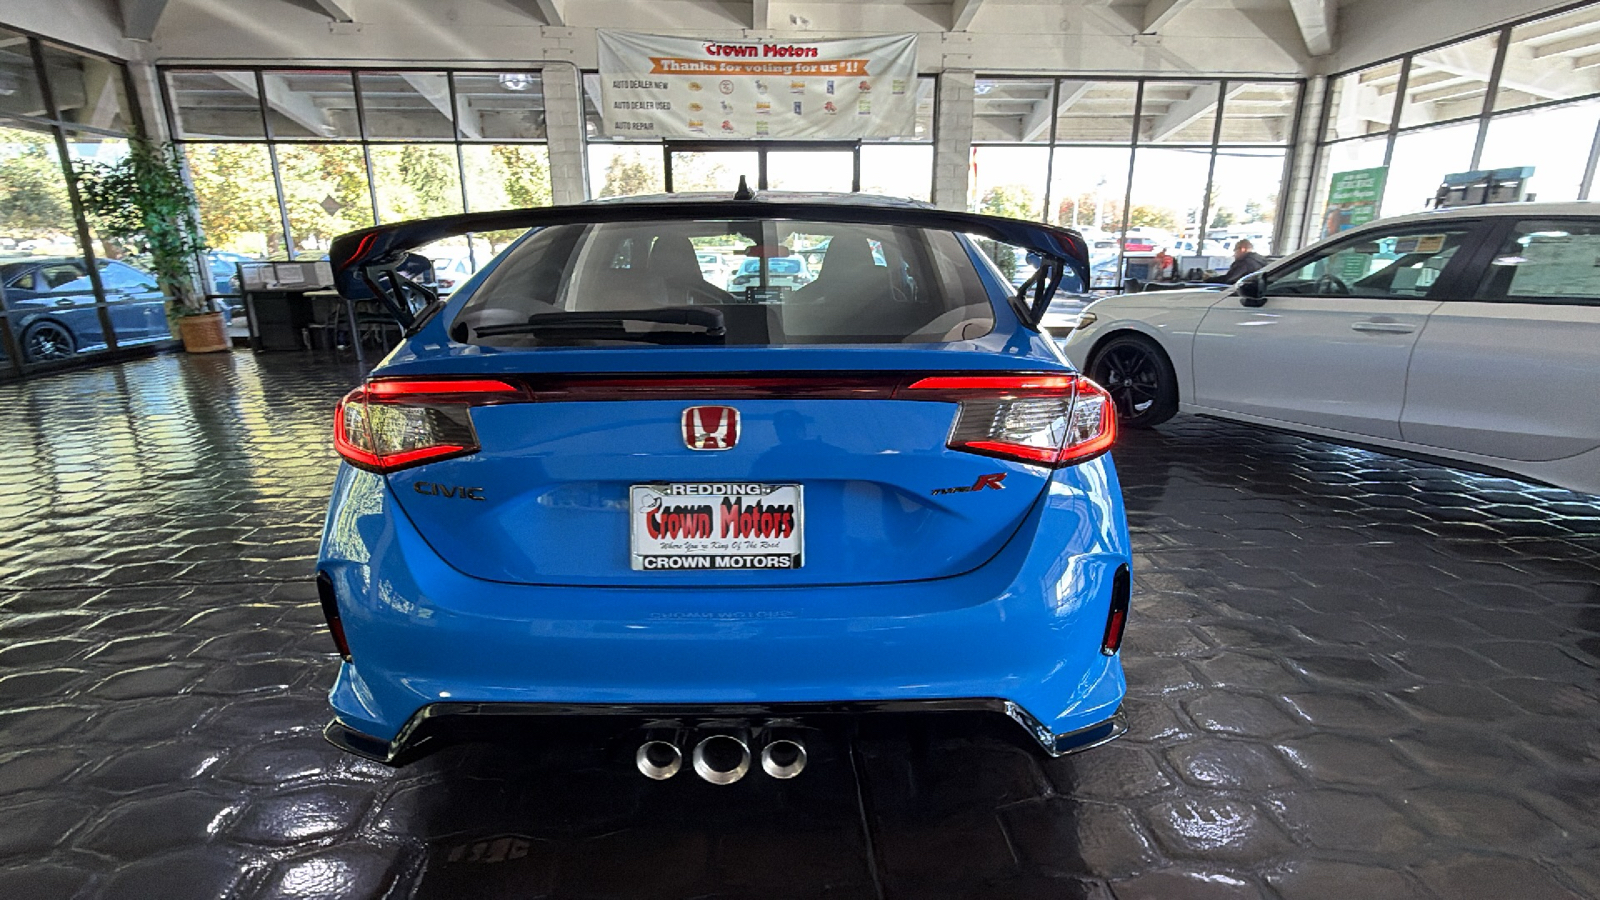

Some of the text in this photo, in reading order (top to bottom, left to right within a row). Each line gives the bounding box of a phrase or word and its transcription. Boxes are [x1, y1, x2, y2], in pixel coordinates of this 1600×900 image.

[705, 42, 818, 58] Crown Motors
[661, 60, 717, 71] Thanks
[719, 62, 742, 72] for
[745, 62, 793, 75] voting
[795, 62, 818, 72] for
[820, 64, 838, 73] us
[613, 80, 669, 90] AUTO DEALER NEW
[614, 101, 671, 110] AUTO DEALER USED
[615, 122, 654, 130] AUTO REPAIR
[413, 481, 486, 501] CIVIC
[672, 484, 760, 495] REDDING
[646, 496, 795, 540] Crown Motors
[660, 542, 683, 550] Where
[711, 541, 729, 551] King
[731, 541, 741, 551] Of
[743, 541, 757, 549] The
[760, 541, 780, 549] Road
[644, 556, 791, 568] CROWN MOTORS
